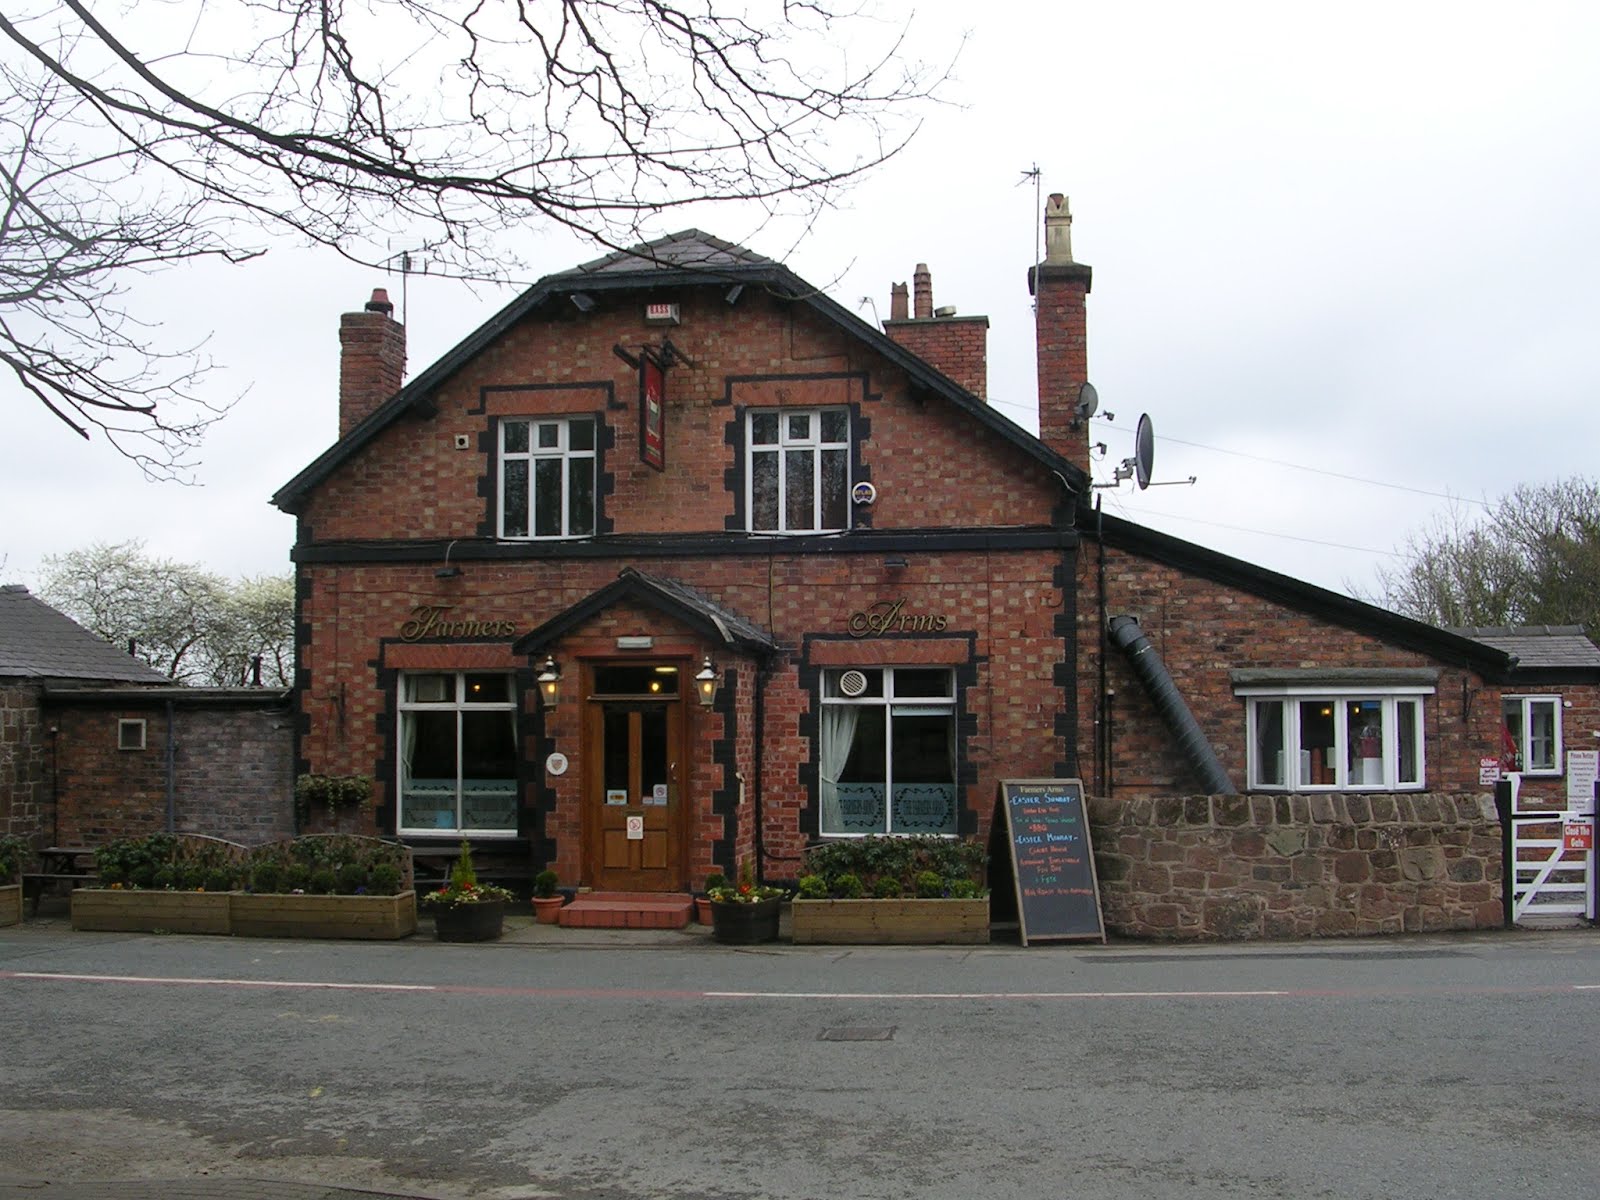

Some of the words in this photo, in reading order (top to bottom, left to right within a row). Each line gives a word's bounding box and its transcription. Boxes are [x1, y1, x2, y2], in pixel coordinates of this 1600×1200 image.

[399, 604, 516, 642] Farmers
[848, 597, 948, 637] Arms
[1570, 838, 1585, 847] Gate
[1580, 826, 1590, 836] The
